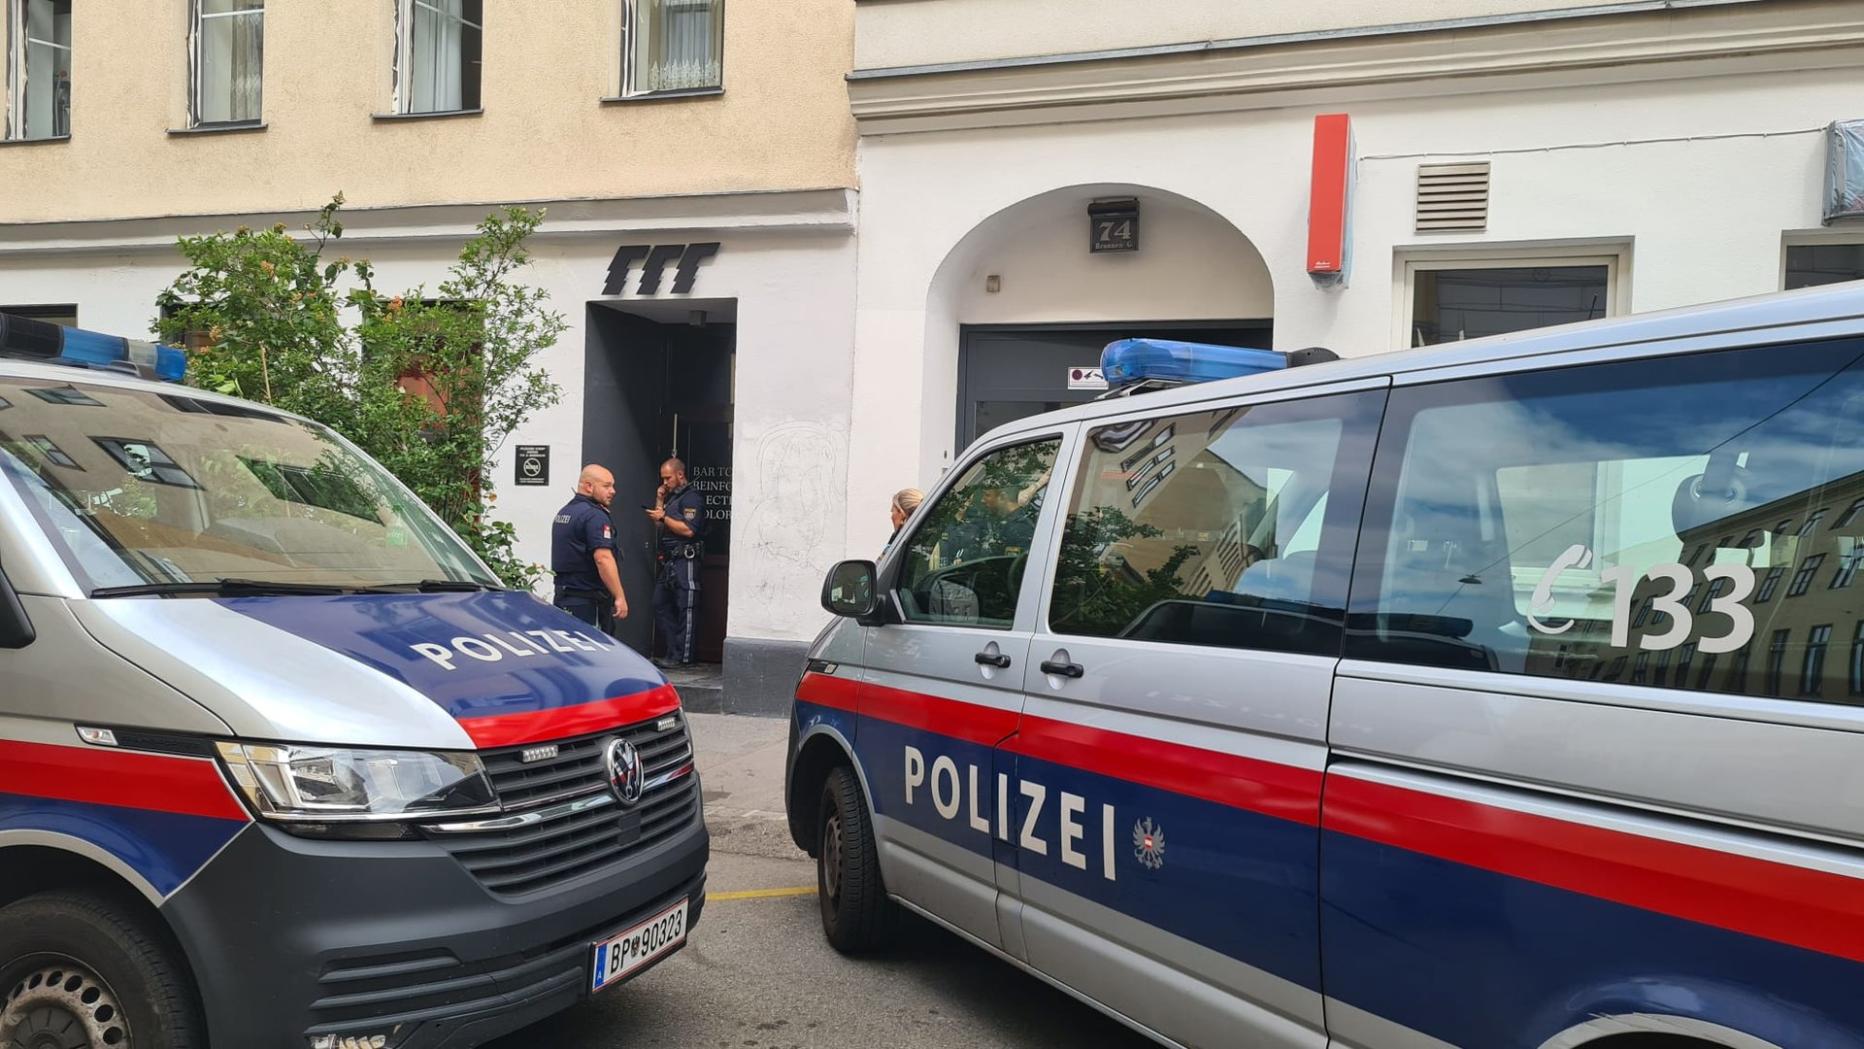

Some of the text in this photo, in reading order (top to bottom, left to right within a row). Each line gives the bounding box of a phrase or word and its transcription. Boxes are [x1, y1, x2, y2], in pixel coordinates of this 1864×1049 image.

[1099, 220, 1131, 241] 74
[693, 466, 715, 477] BAR
[1601, 562, 1755, 653] 133
[409, 630, 612, 671] POLIZEI
[904, 745, 1117, 881] POLIZEI
[610, 908, 682, 974] BP 90323
